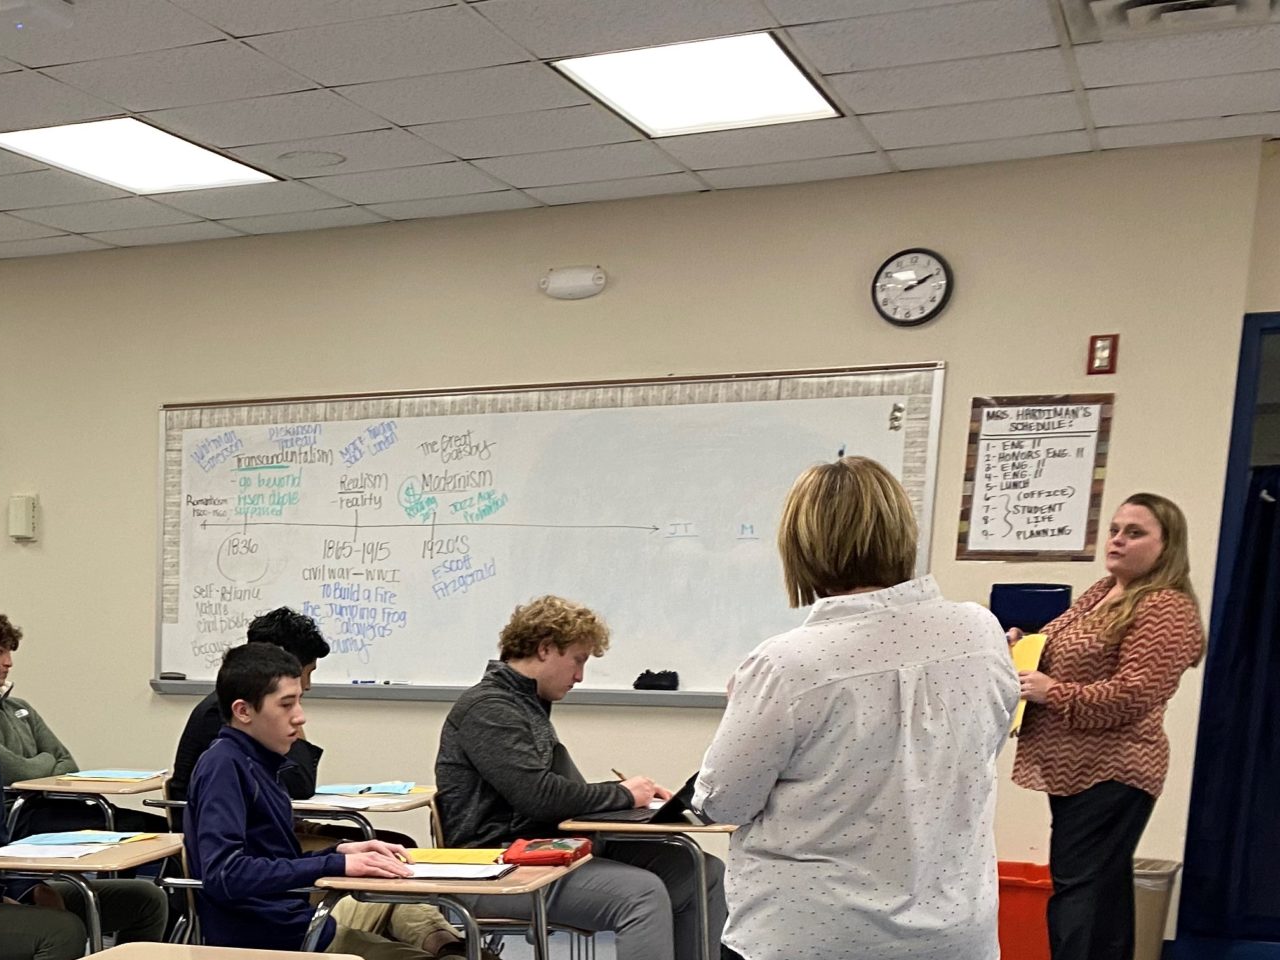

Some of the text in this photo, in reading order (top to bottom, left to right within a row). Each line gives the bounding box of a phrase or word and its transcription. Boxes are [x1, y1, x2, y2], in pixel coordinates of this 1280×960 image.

[440, 429, 474, 451] Great
[339, 472, 389, 492] Realism
[421, 468, 493, 493] Modernism
[1017, 485, 1077, 502] (OFFICE)
[1011, 502, 1067, 516] STUDENT
[1026, 515, 1056, 525] LIFE
[1015, 525, 1073, 541] PLANNING
[227, 538, 259, 557] 1836
[322, 539, 391, 564] 1865-1915
[333, 580, 361, 602] Build
[375, 585, 398, 605] Fire
[381, 606, 408, 629] Frog
